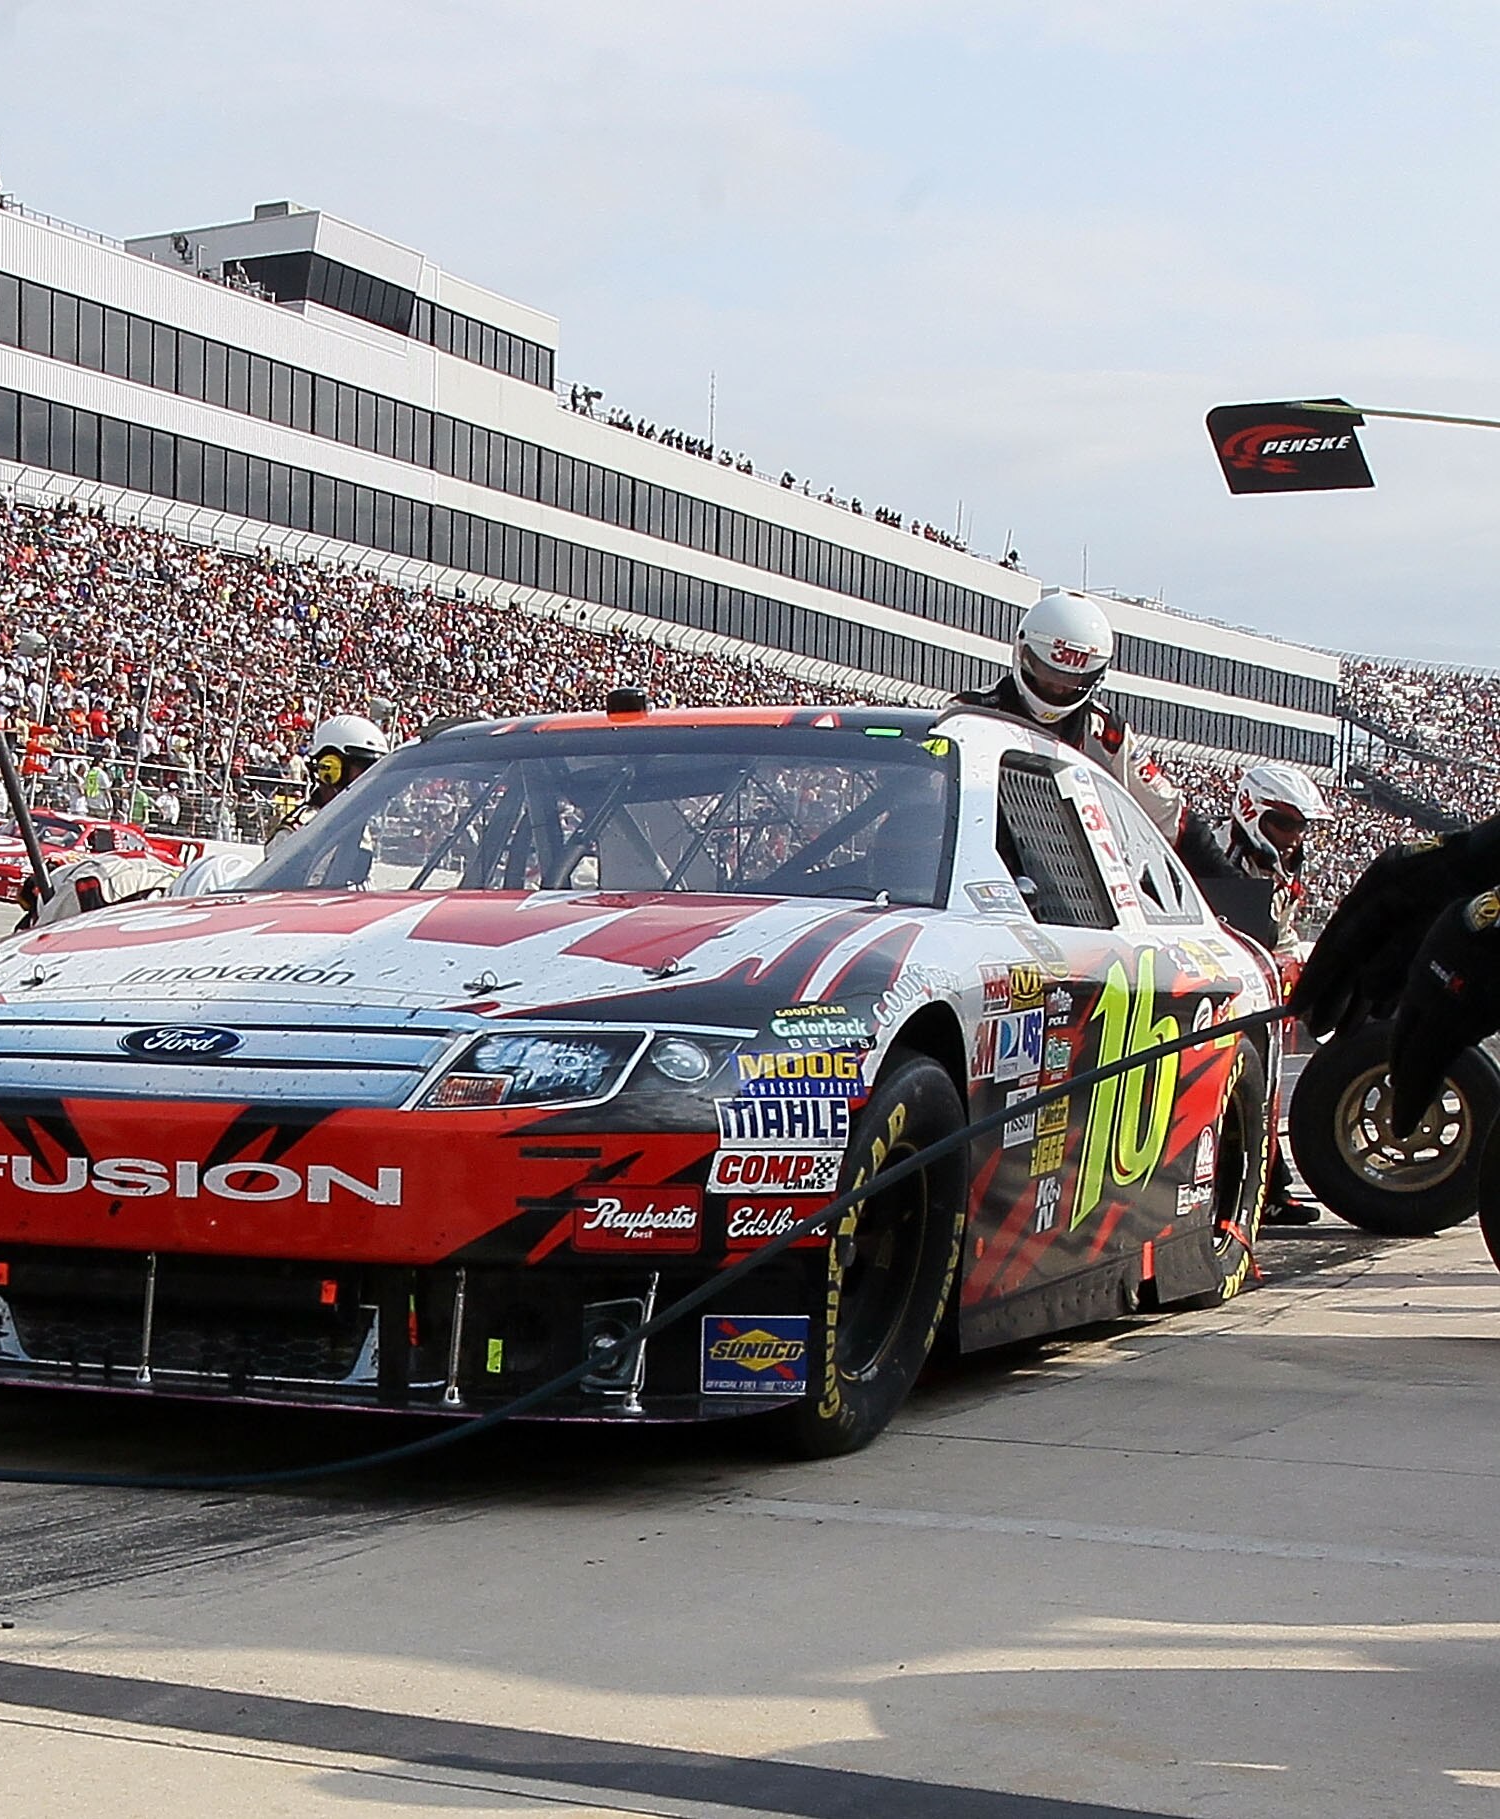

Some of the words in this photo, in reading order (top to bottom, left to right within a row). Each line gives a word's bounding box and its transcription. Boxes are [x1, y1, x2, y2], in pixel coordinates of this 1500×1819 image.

[1262, 435, 1351, 455] PENSKE
[1050, 648, 1089, 668] 3M
[1239, 788, 1258, 822] 3M
[775, 1004, 847, 1018] GOODYEAR
[770, 1017, 868, 1038] Gatorback
[143, 1028, 222, 1051] Ford
[787, 1036, 870, 1050] BELTS
[737, 1052, 859, 1079] MOOG
[748, 1082, 811, 1096] CHASSIS
[820, 1082, 860, 1096] PARTS
[1070, 948, 1180, 1232] 16
[720, 1100, 848, 1140] MAHLE
[716, 1154, 815, 1185] COMP
[783, 1178, 826, 1190] CAMS
[583, 1198, 698, 1238] Raybestos
[727, 1207, 828, 1238] Edelbrk
[711, 1341, 803, 1360] SUNOCO
